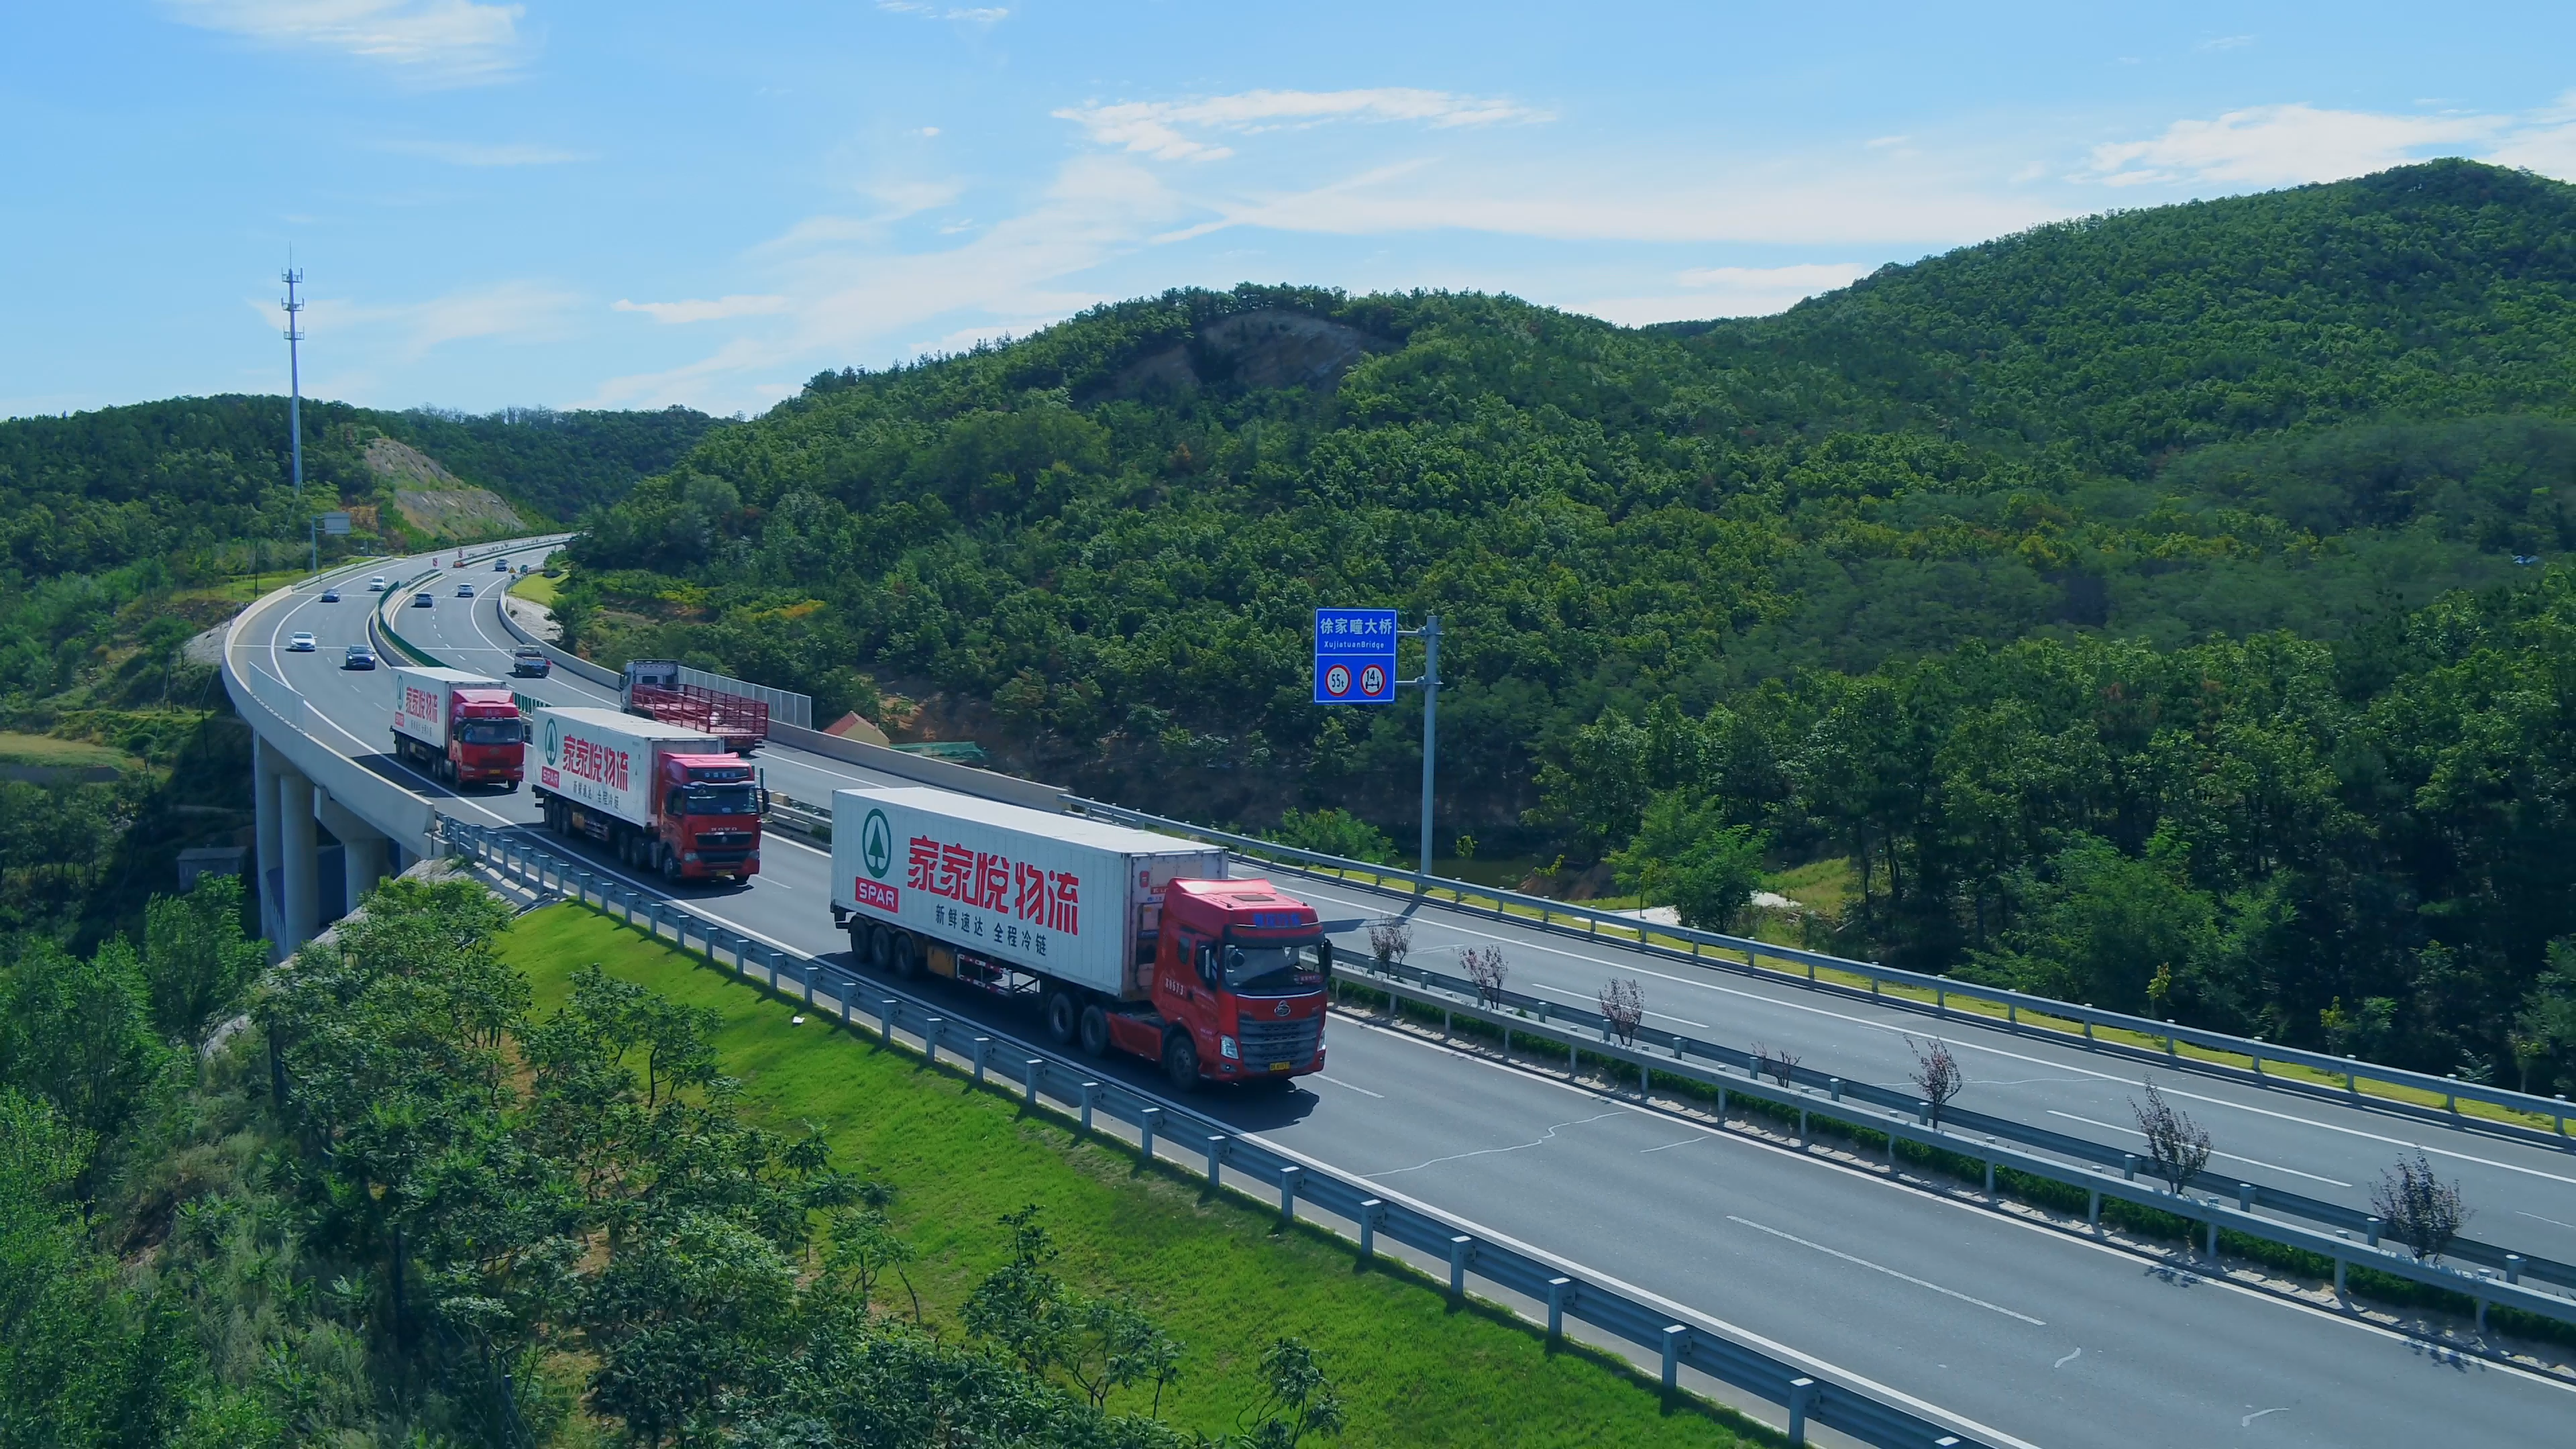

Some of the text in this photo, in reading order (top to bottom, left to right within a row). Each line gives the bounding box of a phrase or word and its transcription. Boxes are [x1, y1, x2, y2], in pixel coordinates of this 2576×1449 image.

[543, 769, 558, 786] SPAR
[563, 734, 629, 792] 家家悦物流
[859, 882, 896, 908] SPAR
[908, 835, 1079, 936] 家家悦物流
[935, 904, 1047, 957] 新鲜速达 全程冷链
